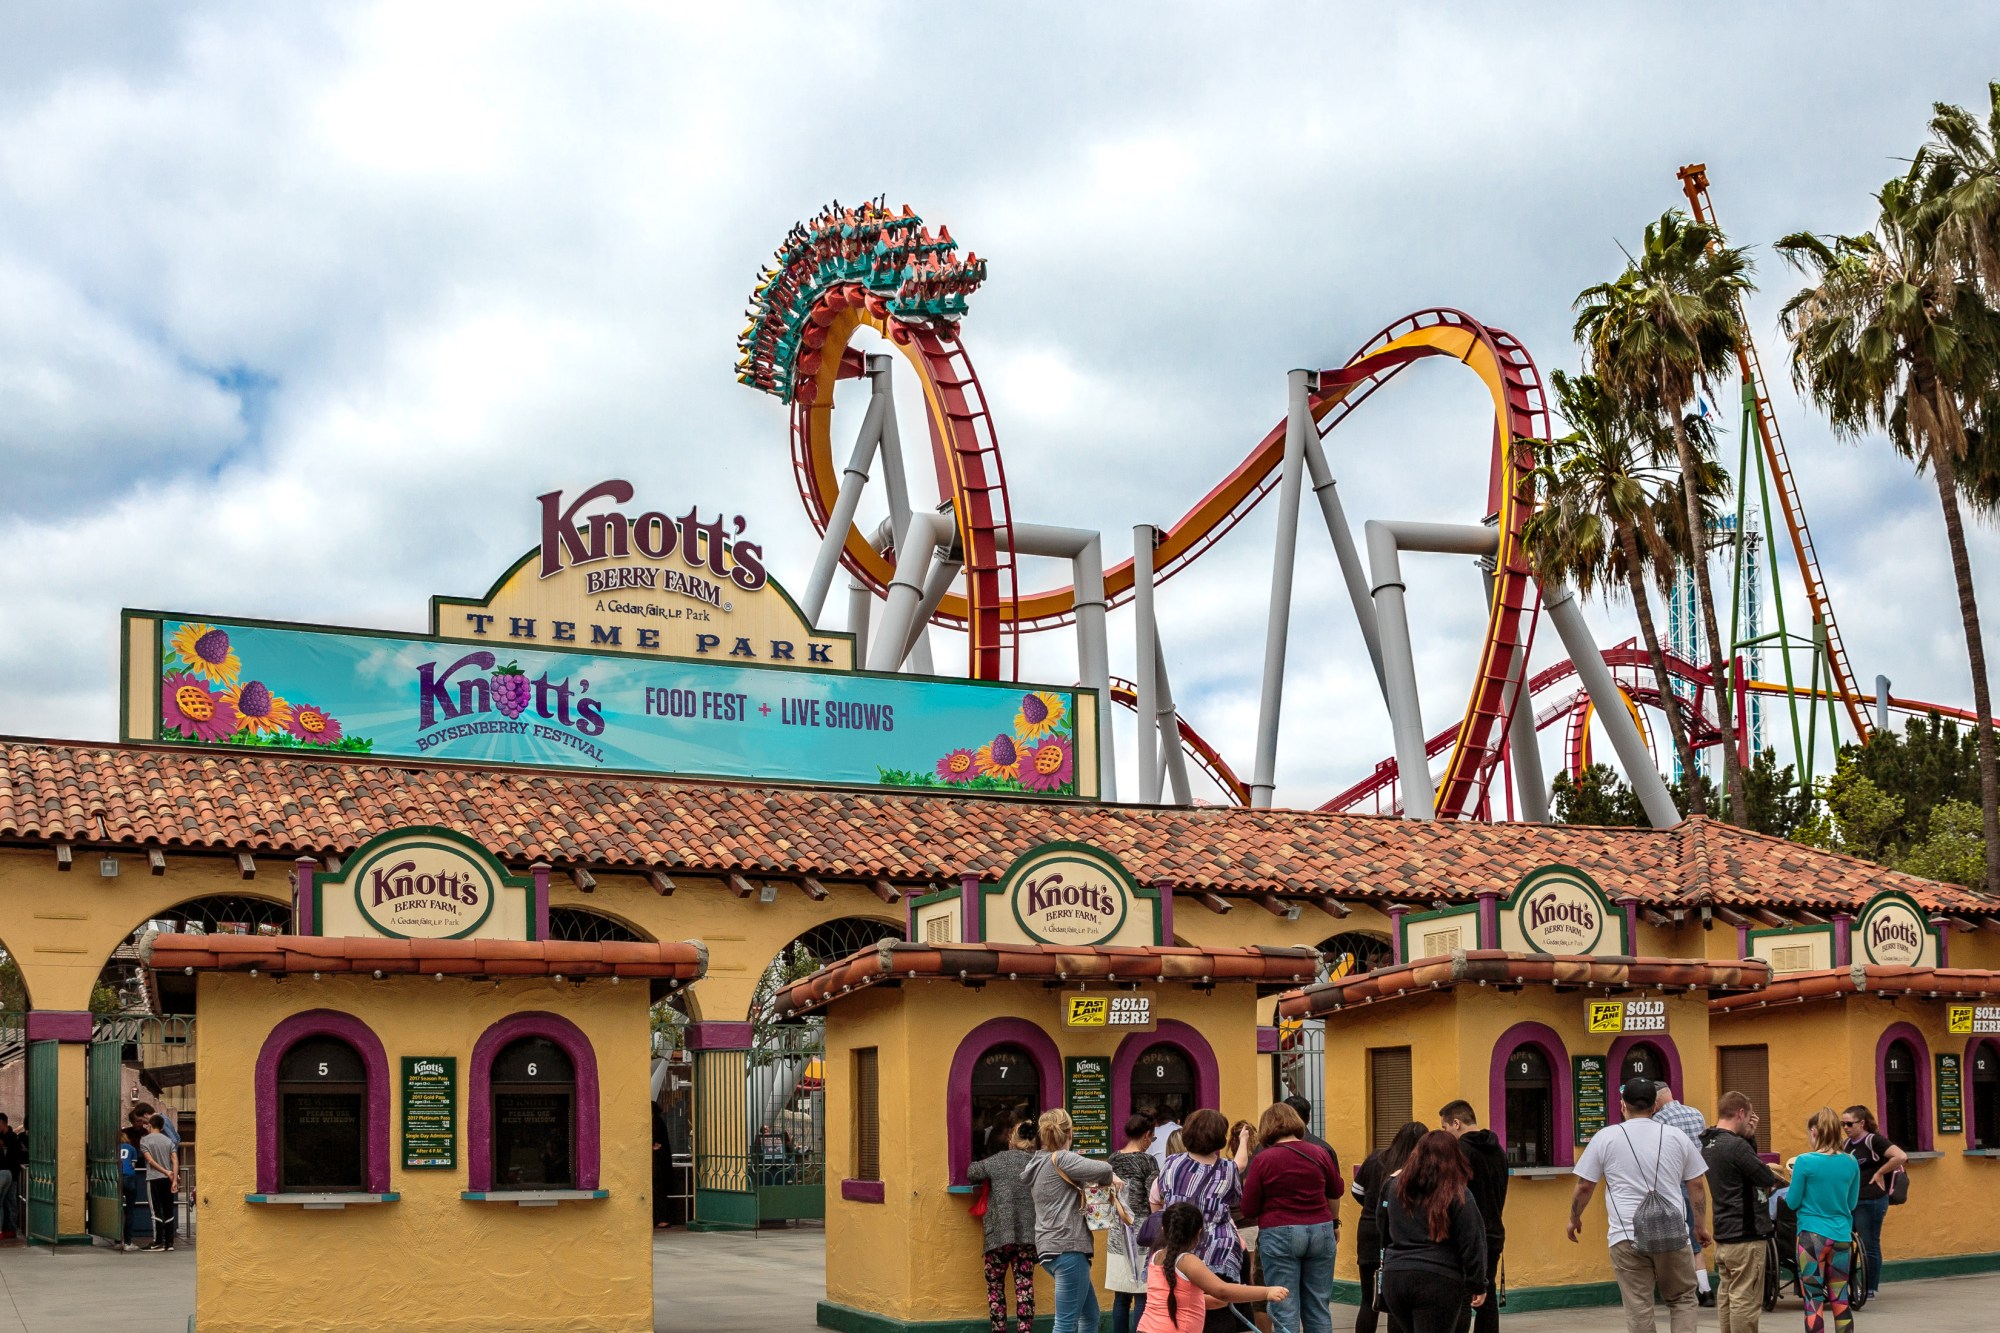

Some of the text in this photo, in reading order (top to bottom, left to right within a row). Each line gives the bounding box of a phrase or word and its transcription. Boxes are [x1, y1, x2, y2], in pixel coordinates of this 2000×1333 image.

[537, 479, 768, 590] Knott's
[586, 567, 721, 608] BERRY FARM
[595, 600, 605, 612] A
[686, 608, 710, 622] Park
[467, 612, 834, 663] THEME PARK
[645, 687, 697, 718] FOOD
[702, 691, 748, 722] FEST
[780, 697, 820, 728] LIVE
[825, 700, 894, 732] SHOWS
[416, 720, 604, 764] BOYSENBERRY FESTIVAL
[370, 860, 478, 908] Knott's
[1026, 873, 1115, 916] Knott's
[395, 900, 456, 914] BERRY FARM
[1530, 892, 1594, 930] Knott's
[444, 918, 460, 926] Park
[1046, 909, 1096, 923] BERRY FARM
[1544, 924, 1582, 936] BERRY FARM
[1872, 915, 1917, 948] Knott's
[1074, 1001, 1104, 1009] FAST
[1112, 998, 1149, 1011] SOLD
[1594, 1006, 1620, 1014] FAST
[1626, 1001, 1664, 1015] SOLD
[1072, 1006, 1102, 1018] LANE
[1109, 1012, 1150, 1024] HERE
[1593, 1012, 1619, 1024] LANE
[1624, 1016, 1665, 1030] HERE
[1952, 1016, 1970, 1026] LANE
[986, 1054, 1016, 1065] OPEN
[1076, 1060, 1100, 1072] Knott's
[1582, 1059, 1599, 1070] Knott's
[1890, 1059, 1898, 1069] 11
[1977, 1060, 1985, 1069] 12
[318, 1062, 328, 1076] 5
[414, 1061, 444, 1074] Knott's
[527, 1062, 537, 1076] 6
[1000, 1066, 1009, 1079] 7
[1156, 1065, 1164, 1078] 8
[1521, 1062, 1528, 1074] 9
[1633, 1062, 1644, 1073] 10
